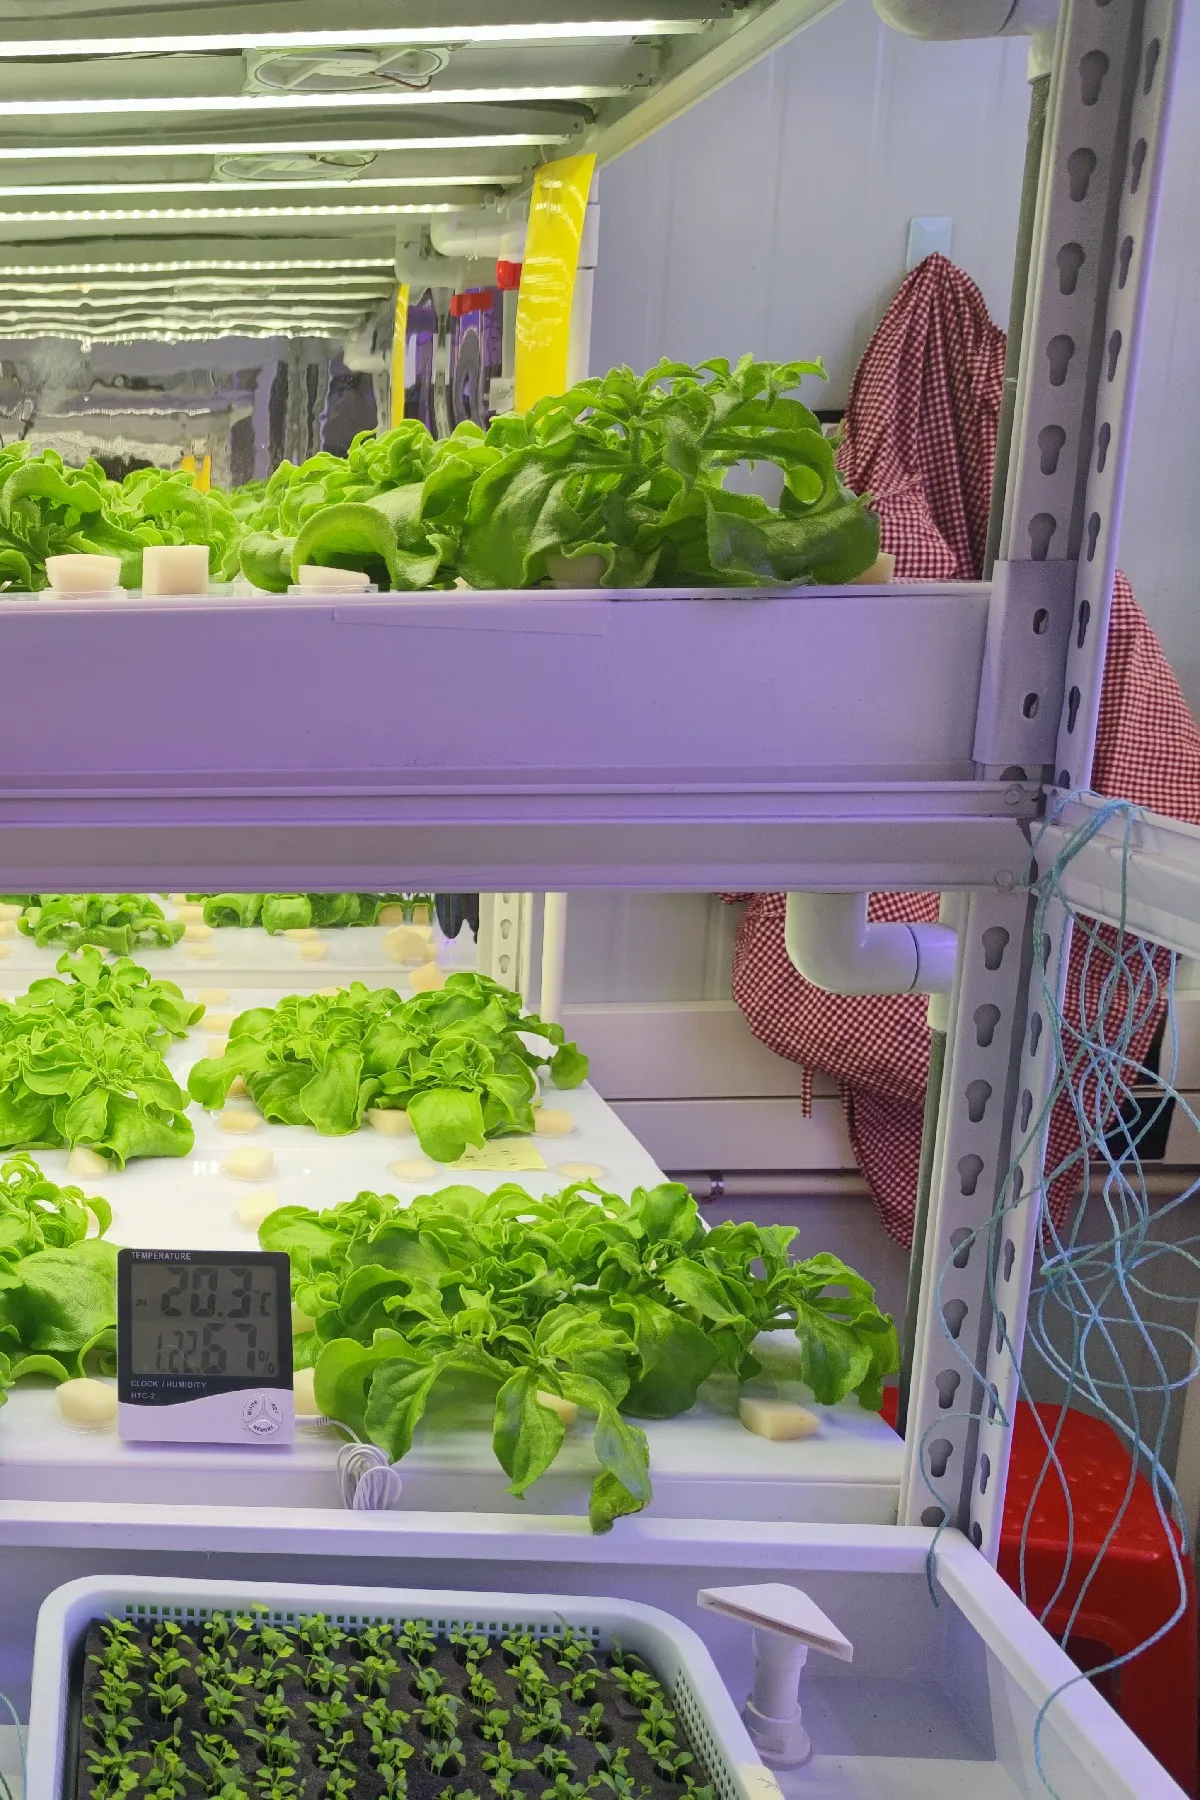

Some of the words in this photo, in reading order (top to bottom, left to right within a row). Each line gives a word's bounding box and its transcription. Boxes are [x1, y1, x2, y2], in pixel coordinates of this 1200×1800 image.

[131, 1251, 192, 1261] TEMPERATURE
[130, 1379, 159, 1388] CLOCK
[166, 1381, 207, 1389] HUMIDITY
